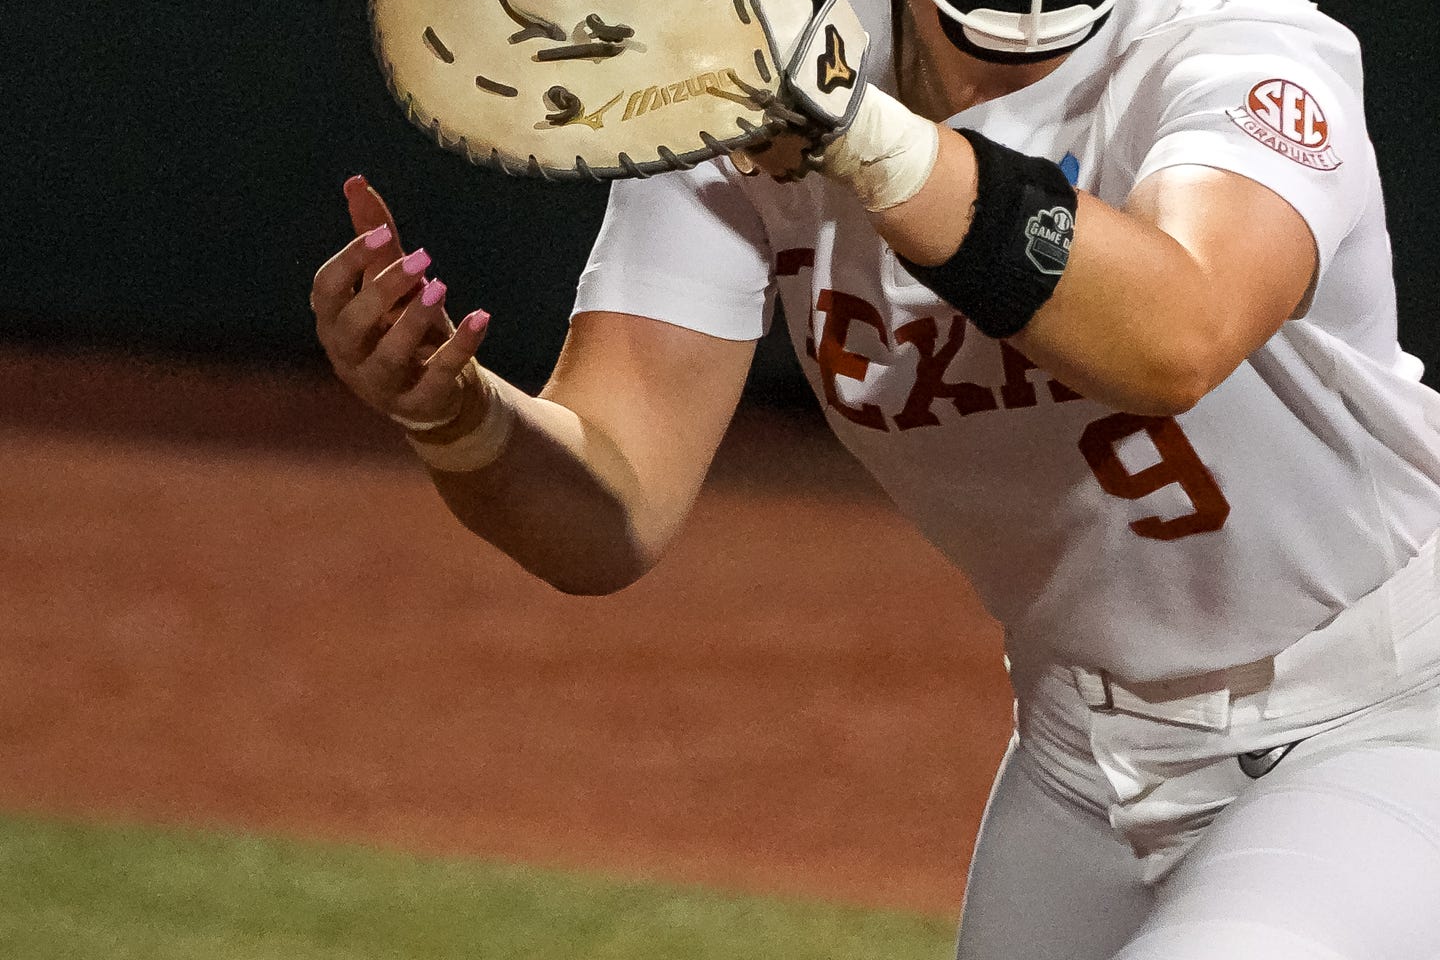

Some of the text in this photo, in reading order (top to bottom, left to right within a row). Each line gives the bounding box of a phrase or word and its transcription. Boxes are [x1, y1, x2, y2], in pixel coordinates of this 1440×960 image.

[1250, 80, 1327, 146] SEC
[1243, 121, 1329, 168] GRADUATE
[1029, 221, 1062, 246] GAME
[1078, 412, 1231, 541] 9
